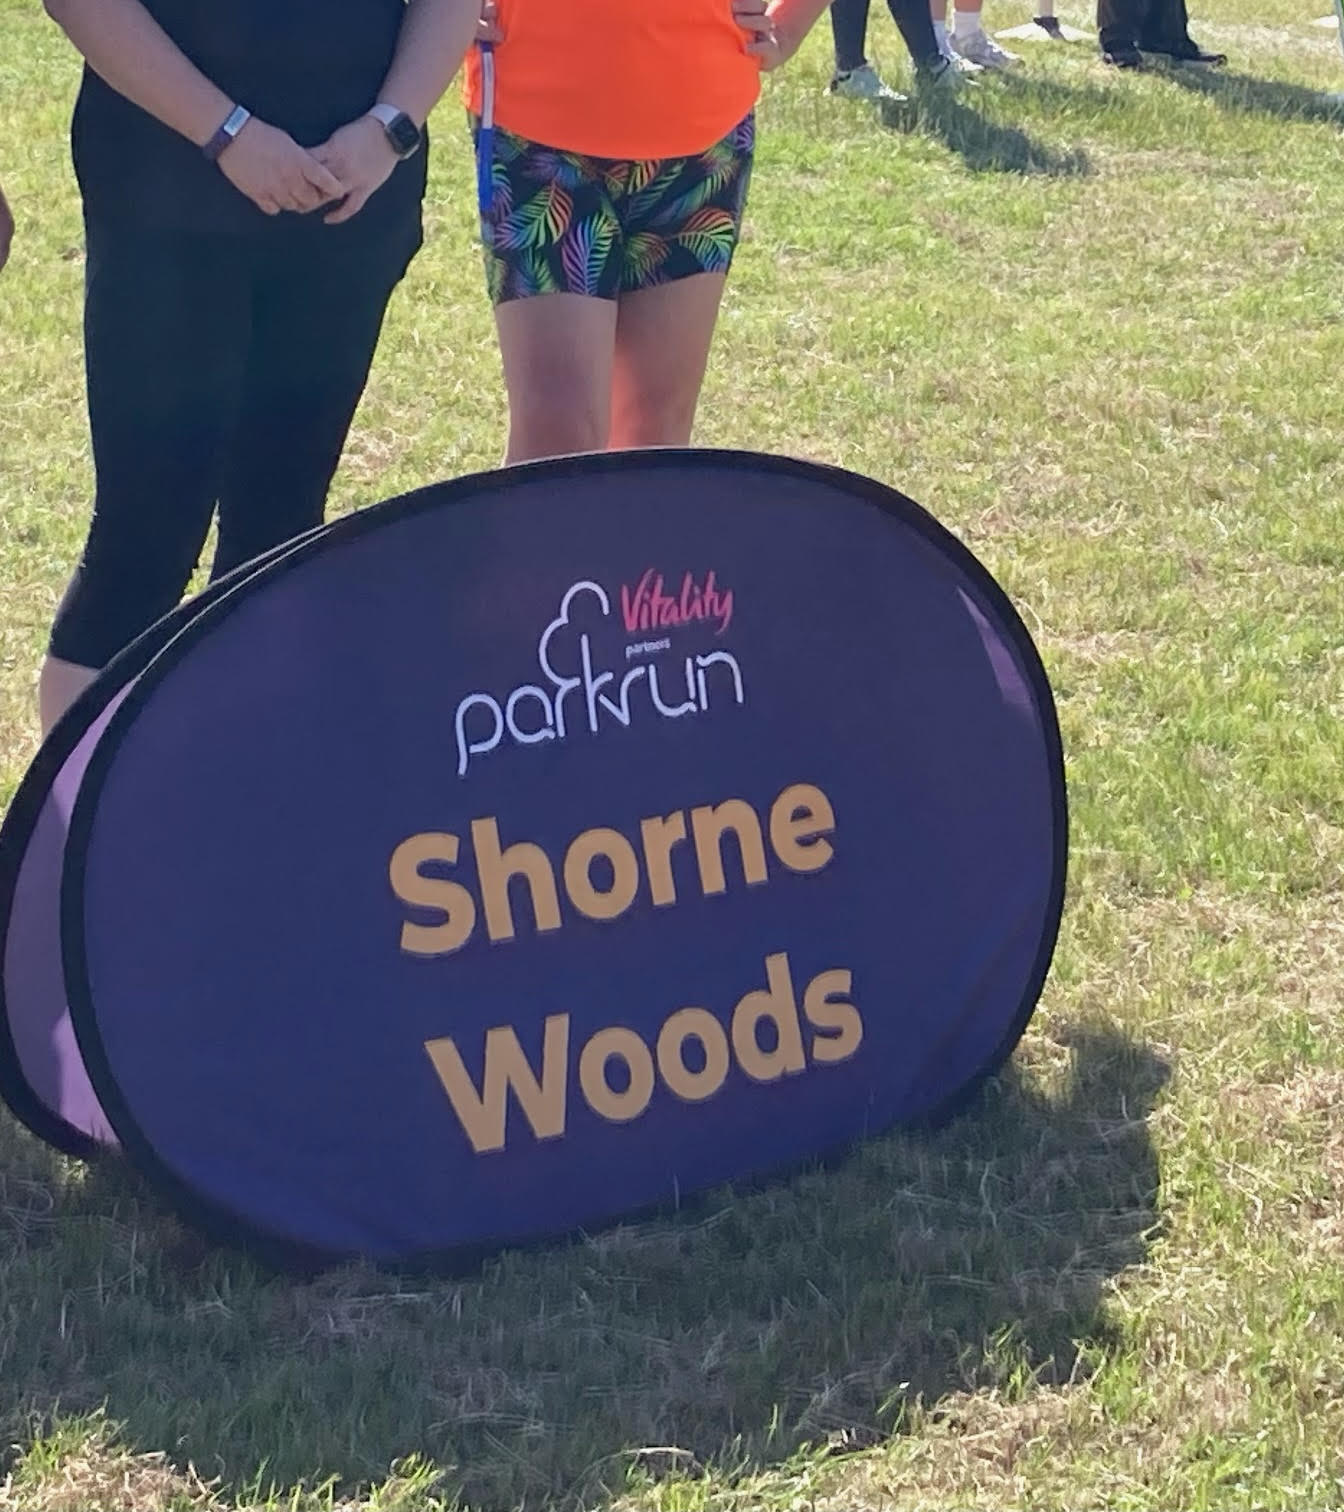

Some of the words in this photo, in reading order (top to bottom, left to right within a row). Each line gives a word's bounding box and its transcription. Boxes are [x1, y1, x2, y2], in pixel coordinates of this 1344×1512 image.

[621, 567, 733, 637] Vitality
[455, 630, 744, 778] parkrun
[388, 783, 836, 958] Shorne
[424, 951, 864, 1154] Woods
